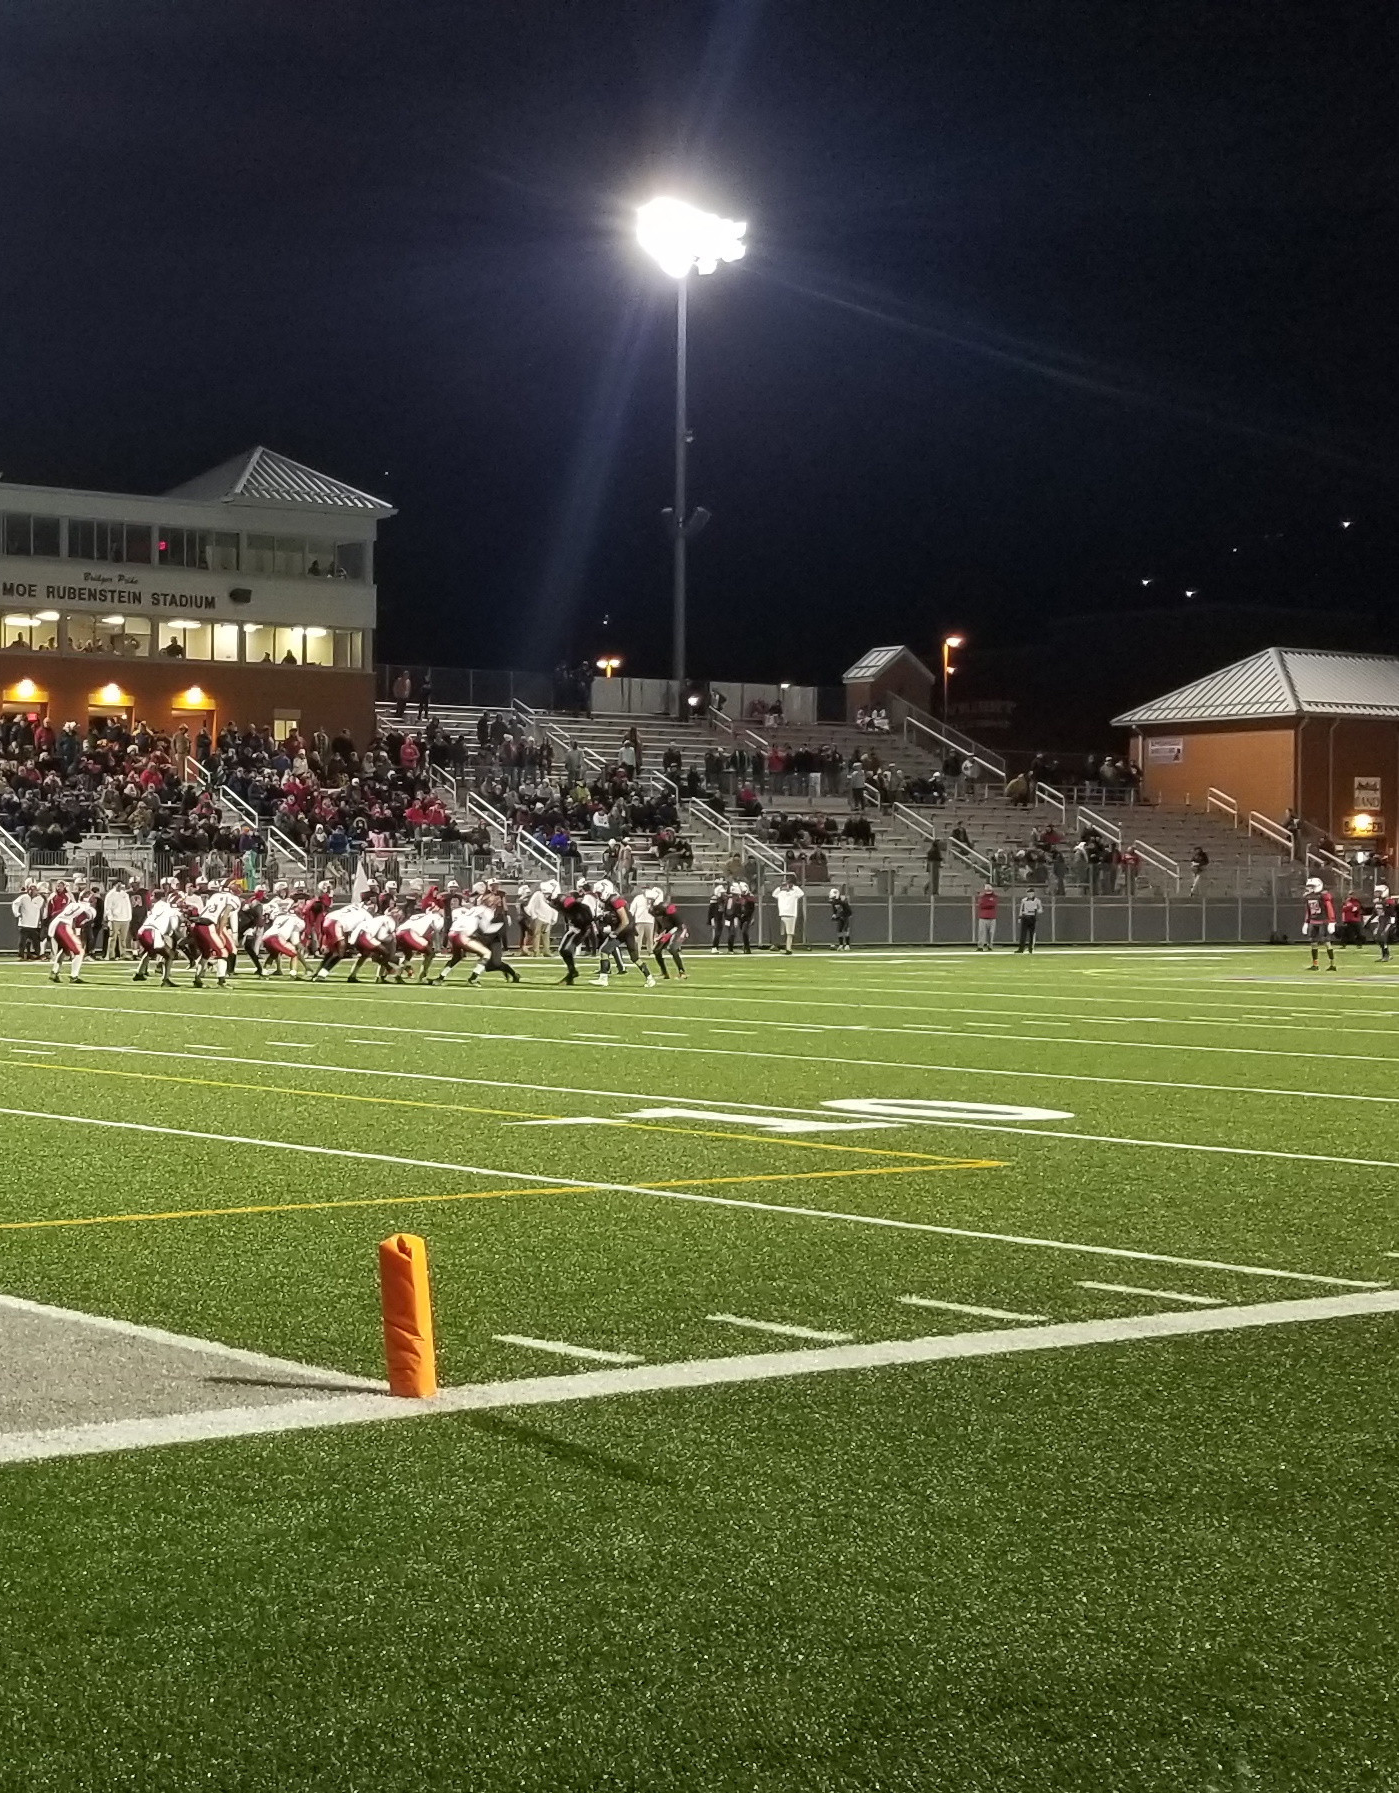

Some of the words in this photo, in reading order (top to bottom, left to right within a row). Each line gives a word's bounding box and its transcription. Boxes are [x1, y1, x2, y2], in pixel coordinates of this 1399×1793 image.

[2, 581, 38, 598] MOE
[46, 585, 142, 604] RUBENSTEIN
[151, 592, 216, 609] STADIUM
